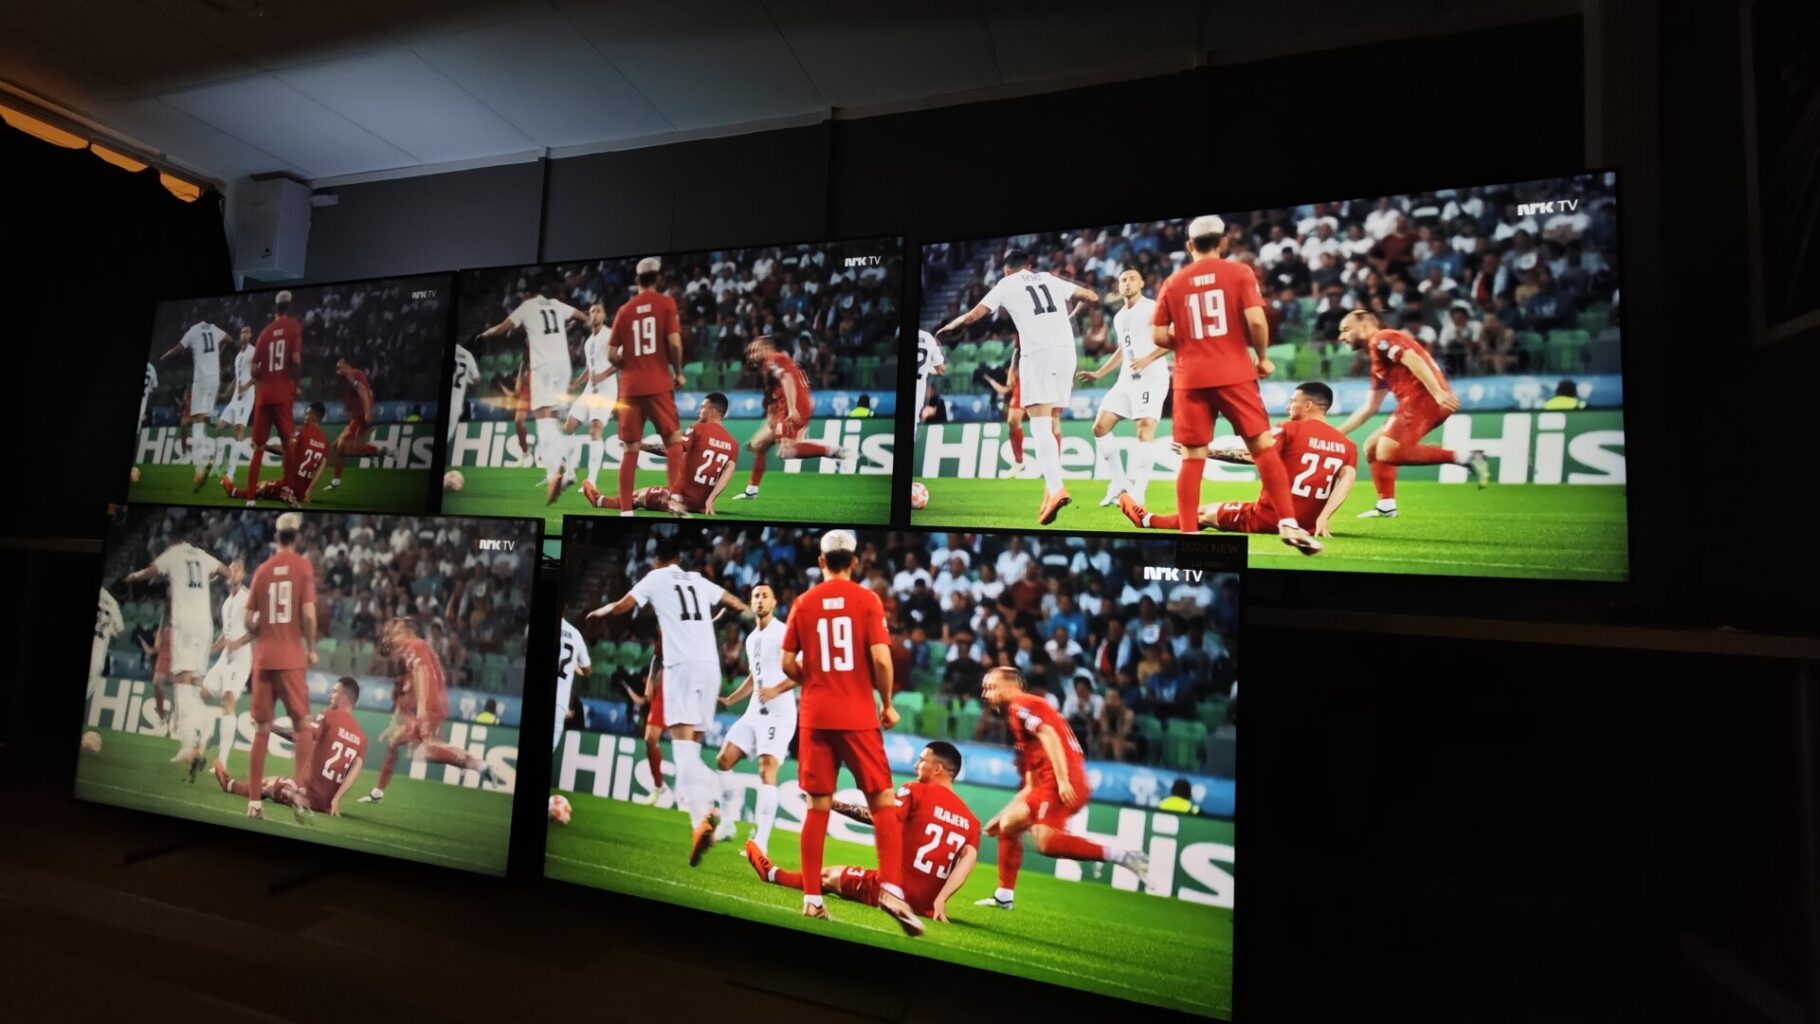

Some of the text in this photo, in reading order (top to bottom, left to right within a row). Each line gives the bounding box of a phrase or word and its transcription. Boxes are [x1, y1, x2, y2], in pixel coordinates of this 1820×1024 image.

[1517, 199, 1579, 216] NRK TV
[844, 255, 881, 267] NRK TV
[1025, 283, 1057, 315] 11
[1186, 288, 1228, 340] 19
[540, 309, 560, 335] 11
[632, 316, 657, 357] 19
[202, 331, 215, 354] 11
[269, 339, 286, 371] 19
[1124, 335, 1132, 347] 9
[1142, 391, 1150, 404] 9
[1439, 412, 1627, 485] His
[694, 449, 729, 486] 23
[1291, 452, 1344, 500] 23
[479, 539, 515, 551] NRK TV
[1144, 566, 1203, 582] NRK TV
[268, 580, 292, 624] 19
[674, 584, 702, 621] 11
[816, 616, 854, 673] 19
[768, 726, 776, 740] 9
[321, 741, 358, 784] 23
[913, 823, 966, 879] 23
